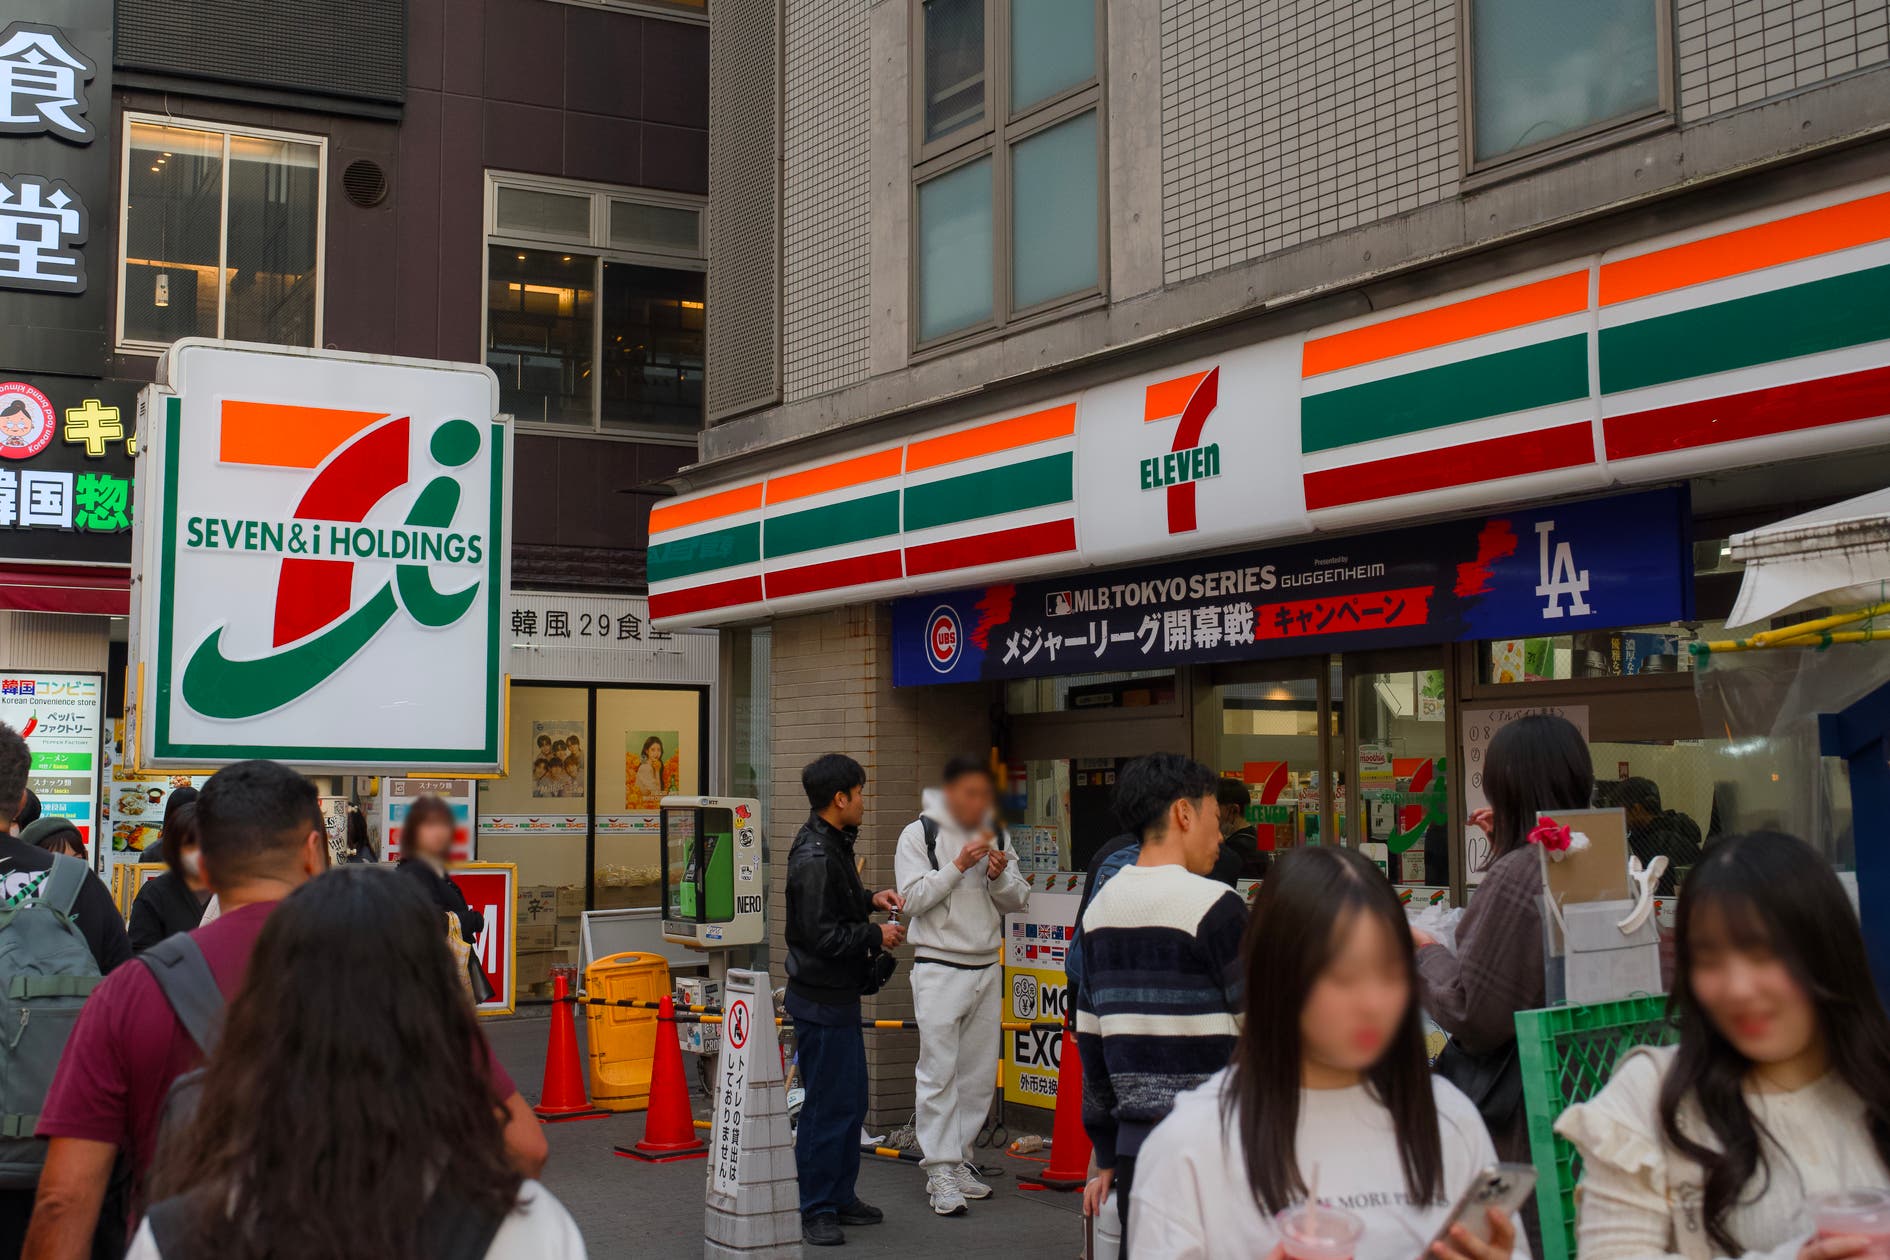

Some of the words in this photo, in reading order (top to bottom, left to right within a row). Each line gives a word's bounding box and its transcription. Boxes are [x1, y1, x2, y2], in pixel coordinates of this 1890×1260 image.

[0, 31, 88, 283] 食堂
[27, 386, 49, 409] brand
[44, 406, 53, 430] food
[64, 399, 138, 457] キ
[28, 430, 52, 454] Korean
[0, 468, 135, 530] 国惣
[330, 526, 483, 565] HOLDINGS
[1281, 563, 1385, 588] GUGGENHEIM
[1535, 520, 1591, 618] LA
[1074, 589, 1111, 613] MLB
[1114, 577, 1187, 608] TOKYO
[1189, 565, 1277, 600] SERIES
[1274, 595, 1406, 635] キャンペーン
[1002, 602, 1255, 665] メジャーリーグ開幕戦
[1, 697, 28, 705] Korean
[29, 698, 75, 706] Convenience
[2, 680, 97, 696] 韓国コンビニ
[40, 724, 93, 734] ファクトリー
[48, 712, 86, 722] ペッパー
[737, 895, 762, 914] NERO
[729, 1055, 745, 1181] トイレの貸出は
